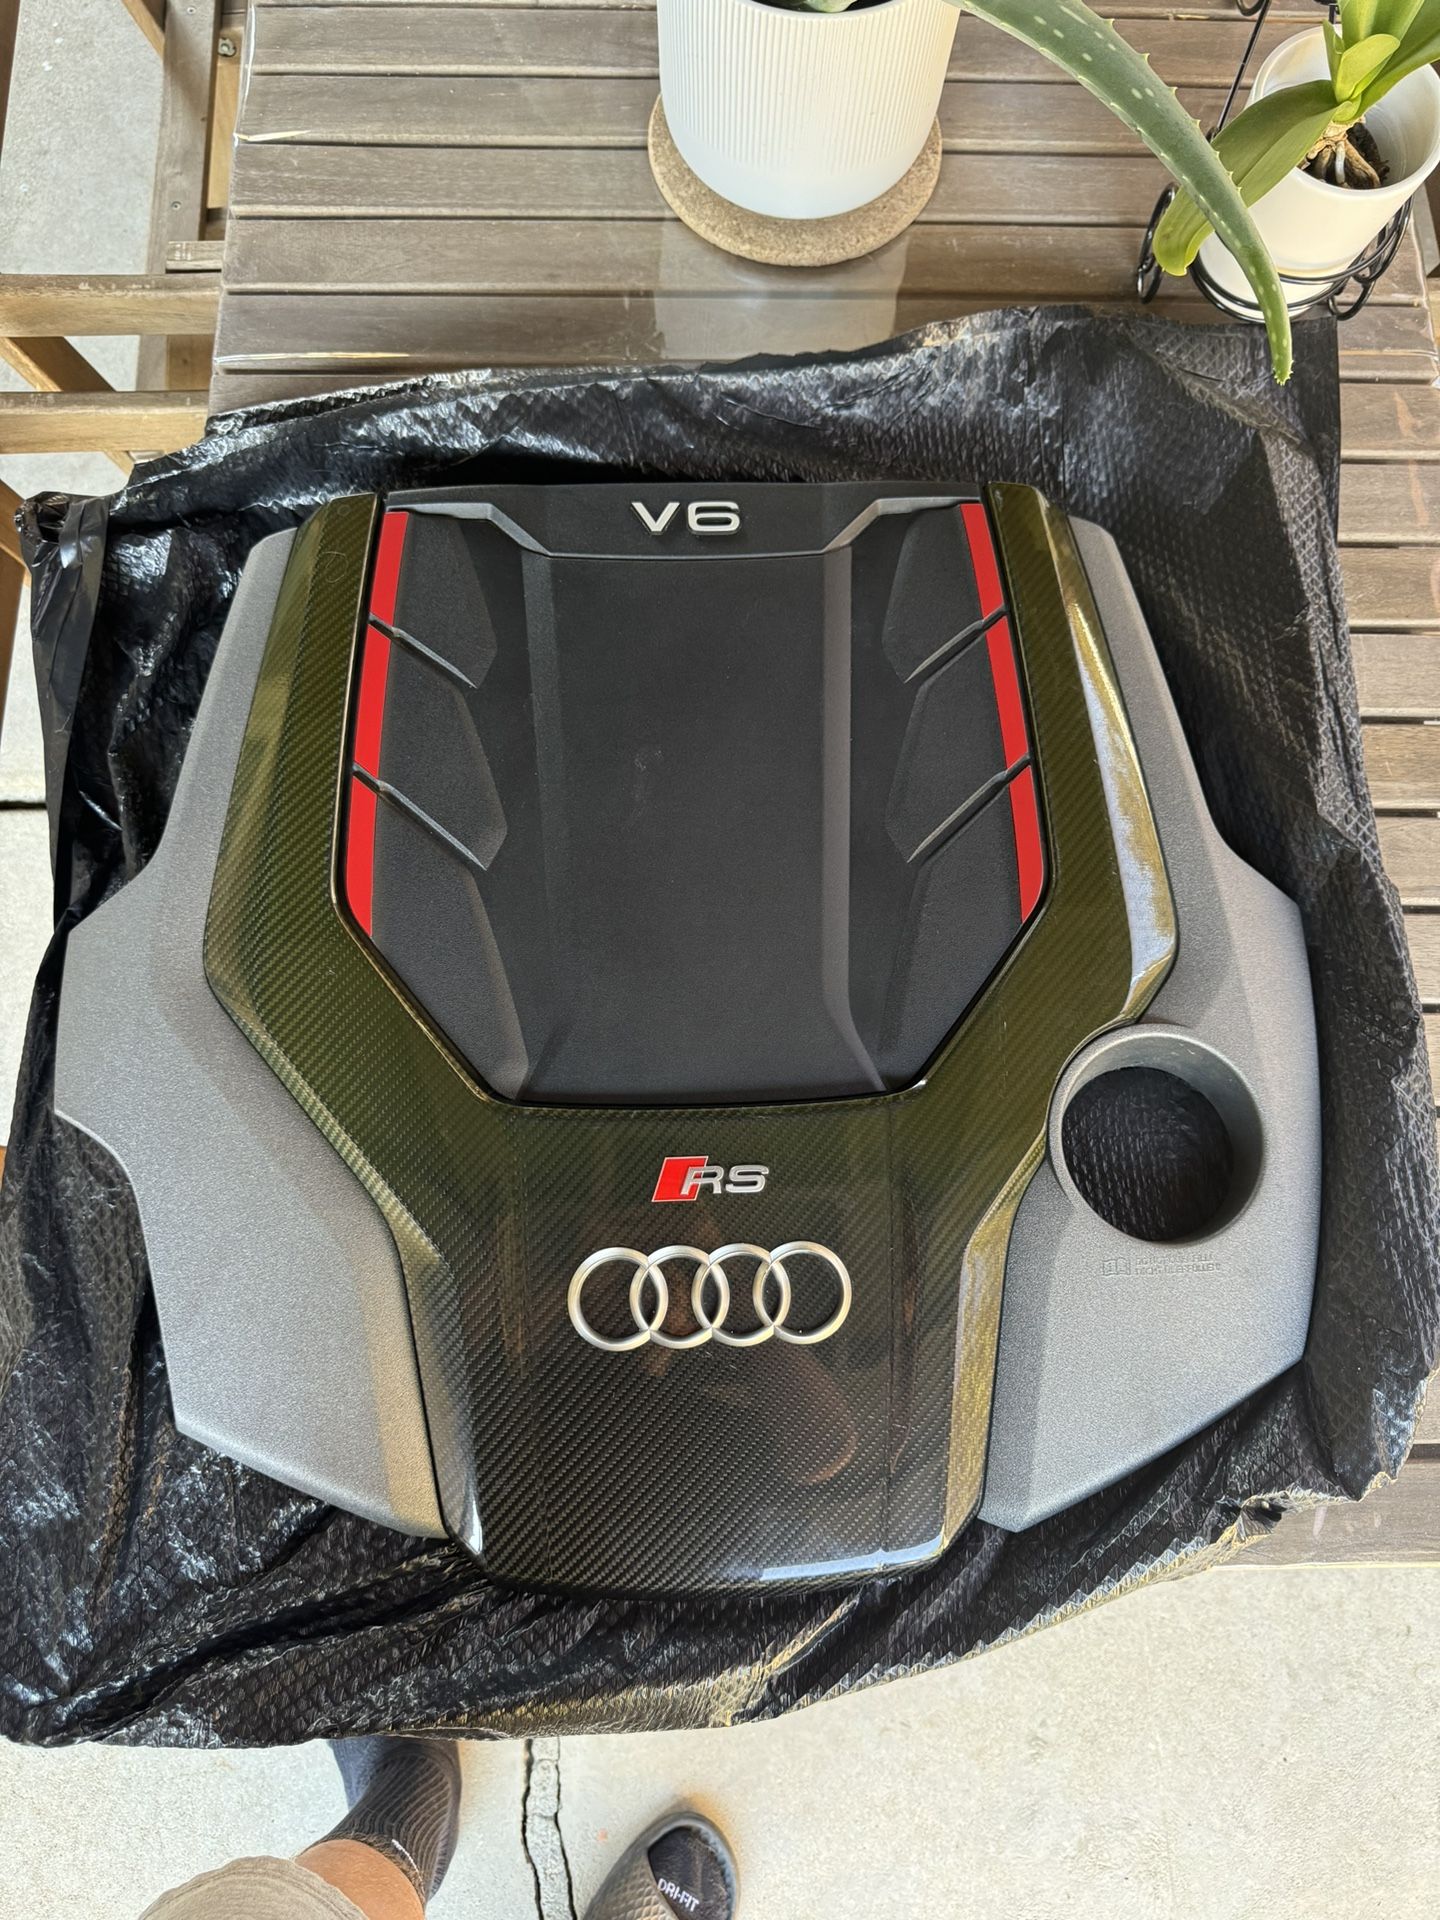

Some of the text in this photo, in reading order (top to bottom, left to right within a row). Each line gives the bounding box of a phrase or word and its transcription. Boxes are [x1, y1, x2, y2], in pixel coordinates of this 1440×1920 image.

[631, 501, 741, 534] V6
[680, 1164, 770, 1196] RS
[657, 1878, 700, 1912] DRI-FIT
